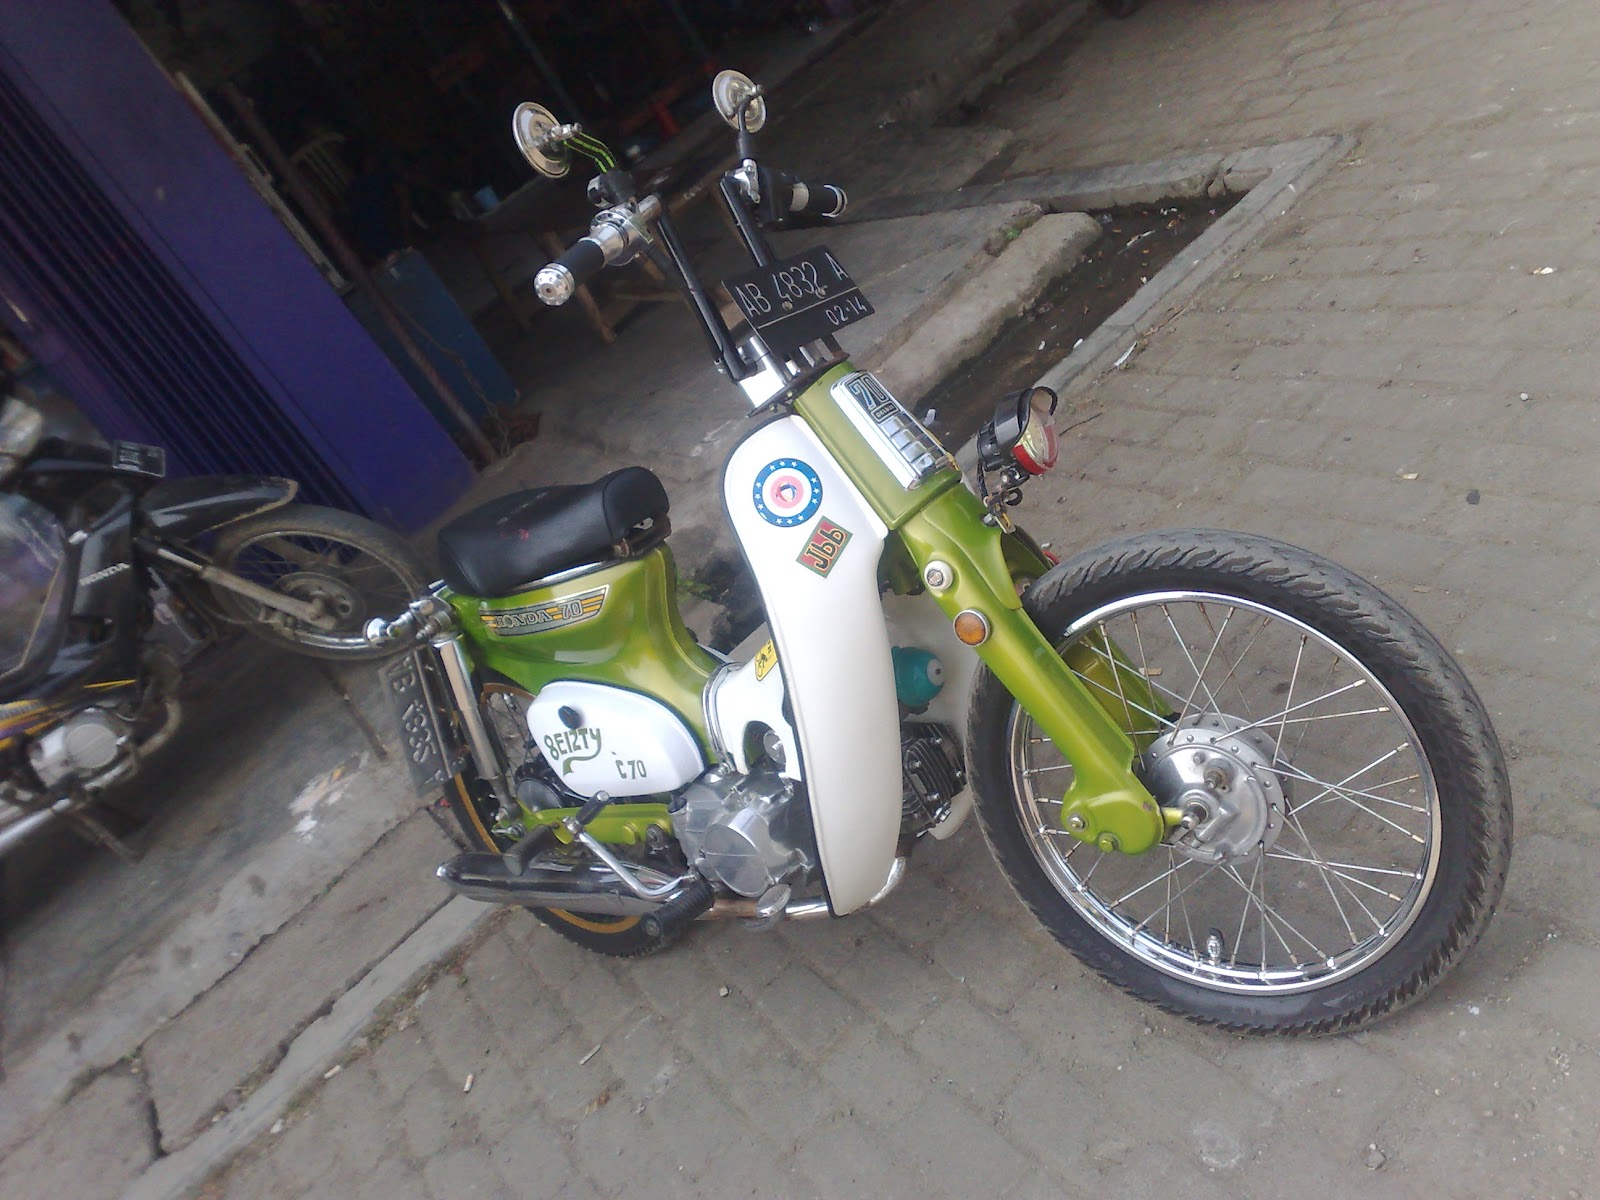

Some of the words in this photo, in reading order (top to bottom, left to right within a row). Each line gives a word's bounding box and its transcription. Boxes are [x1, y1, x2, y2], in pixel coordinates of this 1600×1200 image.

[735, 283, 772, 318] AB
[772, 261, 828, 302] 4832
[825, 252, 849, 281] A
[848, 373, 889, 411] 70
[558, 600, 584, 620] 70
